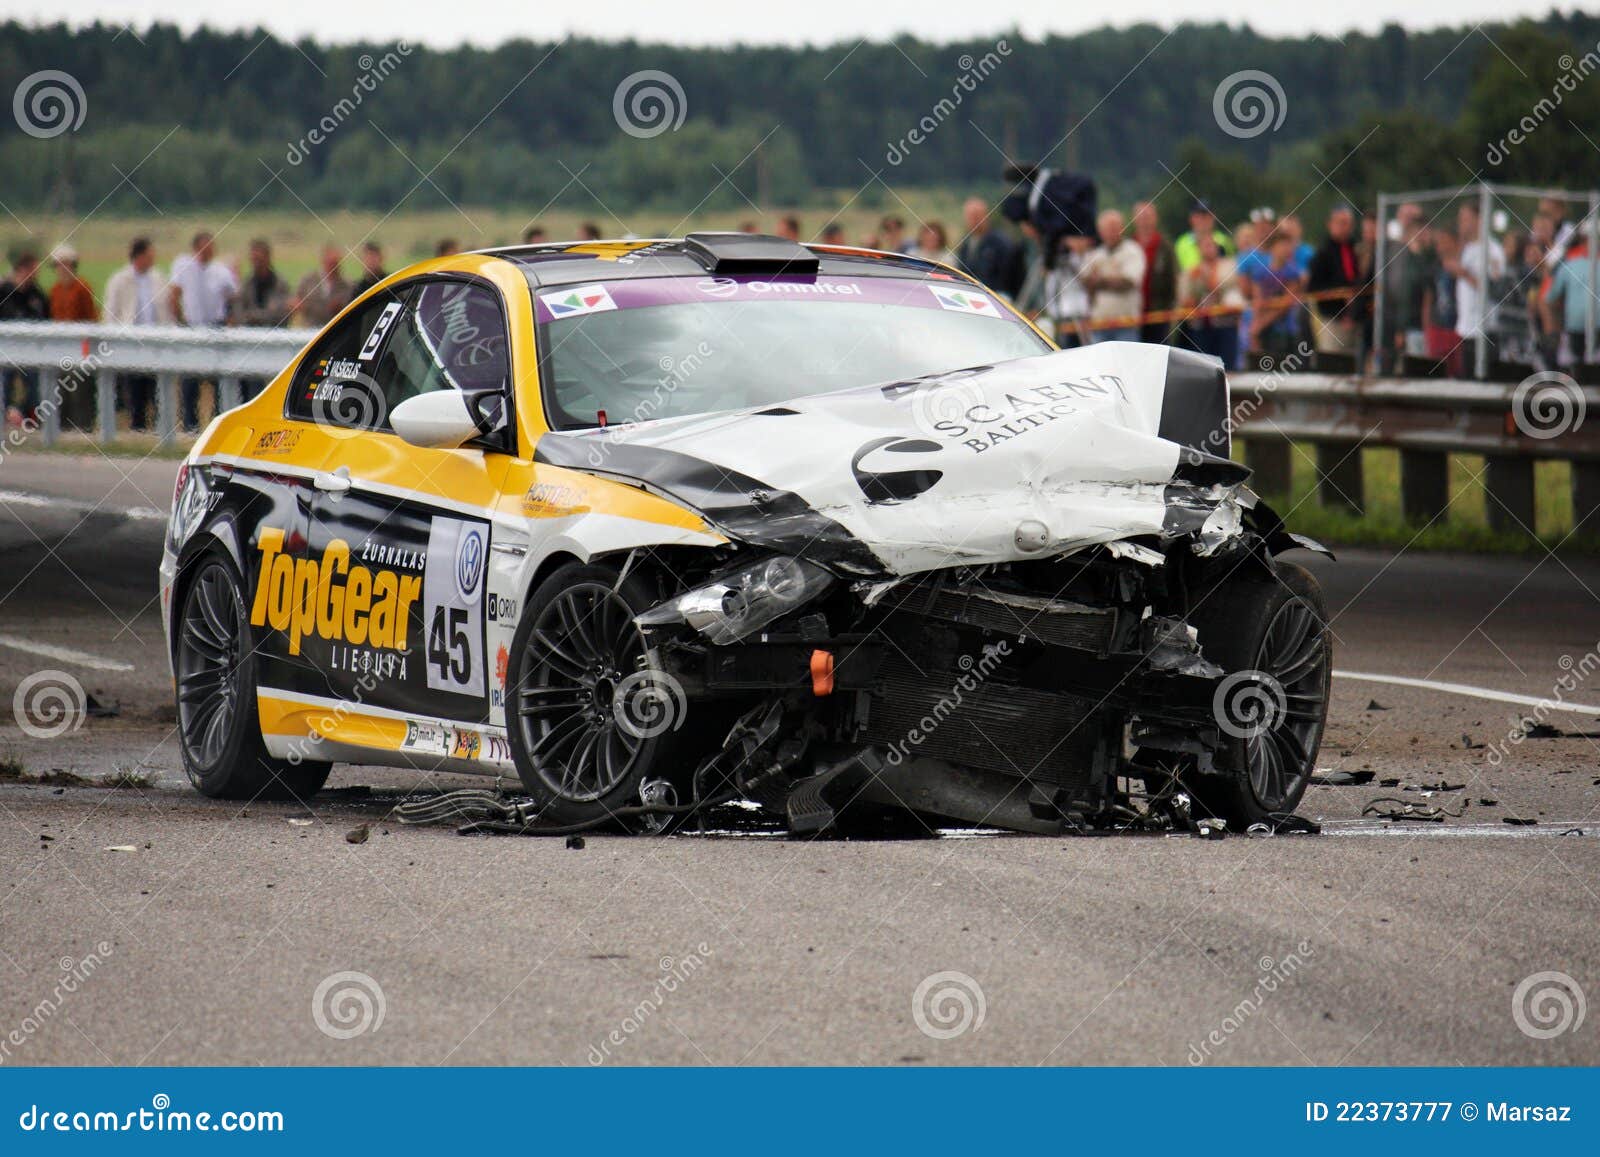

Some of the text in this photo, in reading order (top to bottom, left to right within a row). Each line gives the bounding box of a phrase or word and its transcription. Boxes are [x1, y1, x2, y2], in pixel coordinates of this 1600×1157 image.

[746, 280, 863, 296] Omnitel
[934, 374, 1130, 438] SCAENT
[962, 403, 1077, 454] BALTIC
[362, 538, 427, 571] ŽURNALAS
[250, 526, 422, 657] TopGear
[332, 646, 407, 681] LIETUVA
[428, 605, 472, 685] 45
